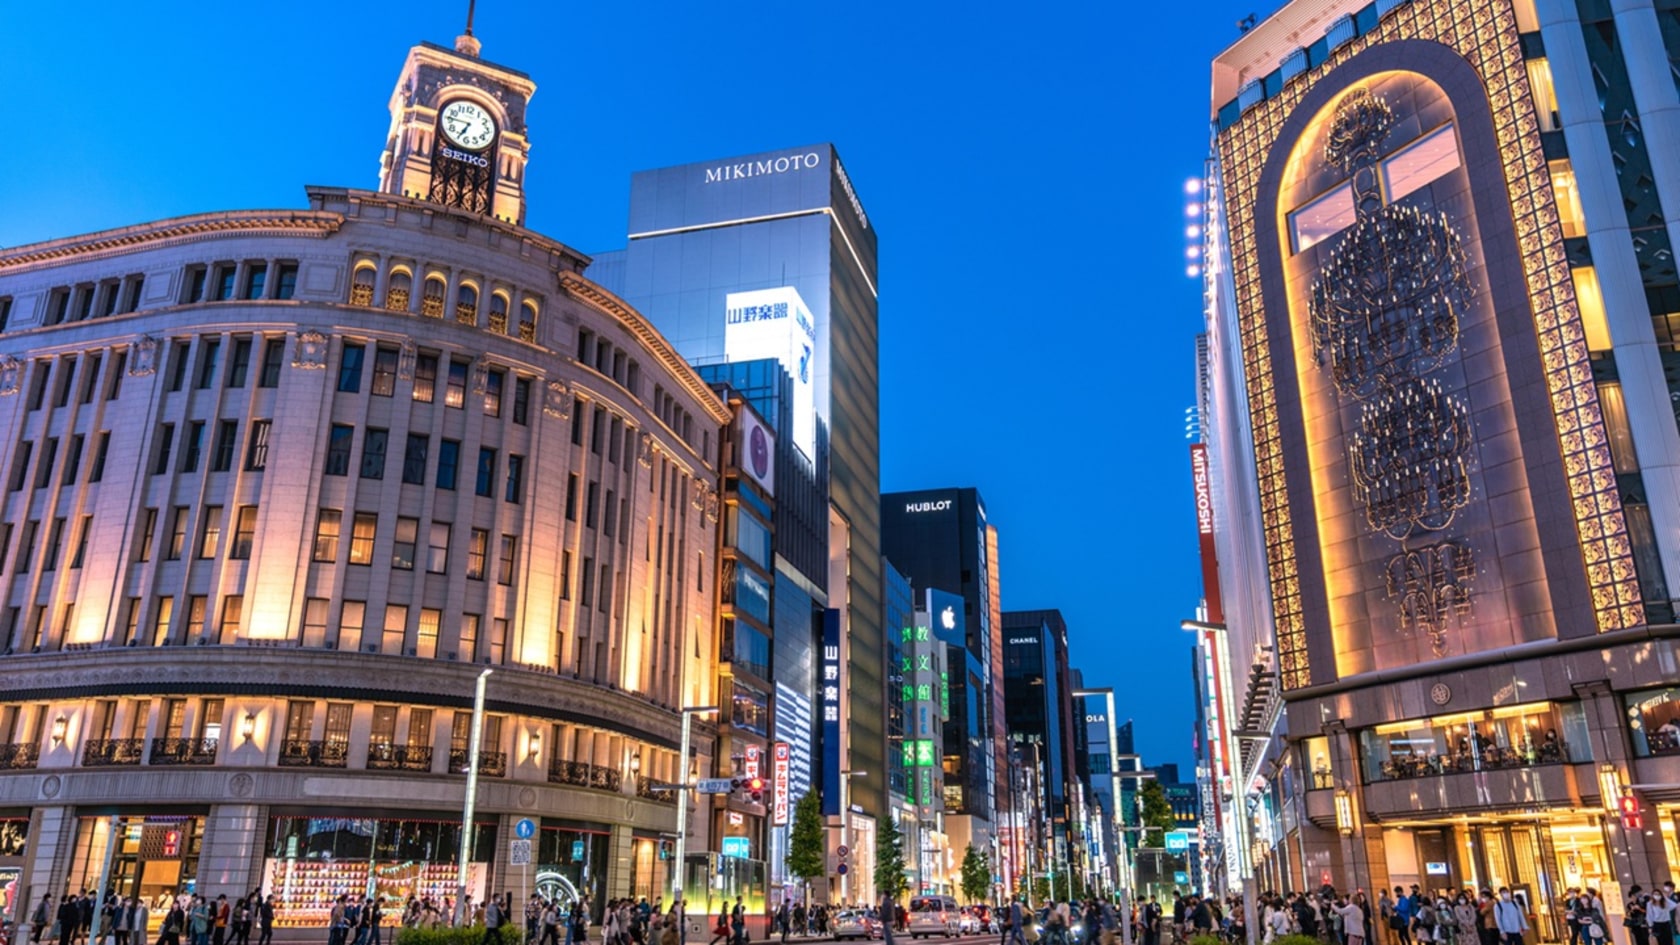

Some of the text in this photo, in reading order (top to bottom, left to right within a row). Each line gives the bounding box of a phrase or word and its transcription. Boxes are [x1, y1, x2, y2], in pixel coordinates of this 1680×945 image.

[450, 109, 458, 117] 10
[458, 104, 465, 114] 11
[466, 106, 475, 115] 12
[482, 117, 488, 126] 2
[449, 123, 456, 133] 8
[462, 136, 470, 145] 6
[472, 136, 479, 145] 5
[442, 148, 488, 168] SEIKO
[705, 152, 820, 184] MIKIMOTO
[728, 301, 788, 325] 山野楽器
[1192, 449, 1211, 534] MITSUKOSHI
[906, 500, 952, 513] HUBLOT
[1009, 636, 1039, 645] CHANEL
[824, 645, 838, 722] 山野楽器
